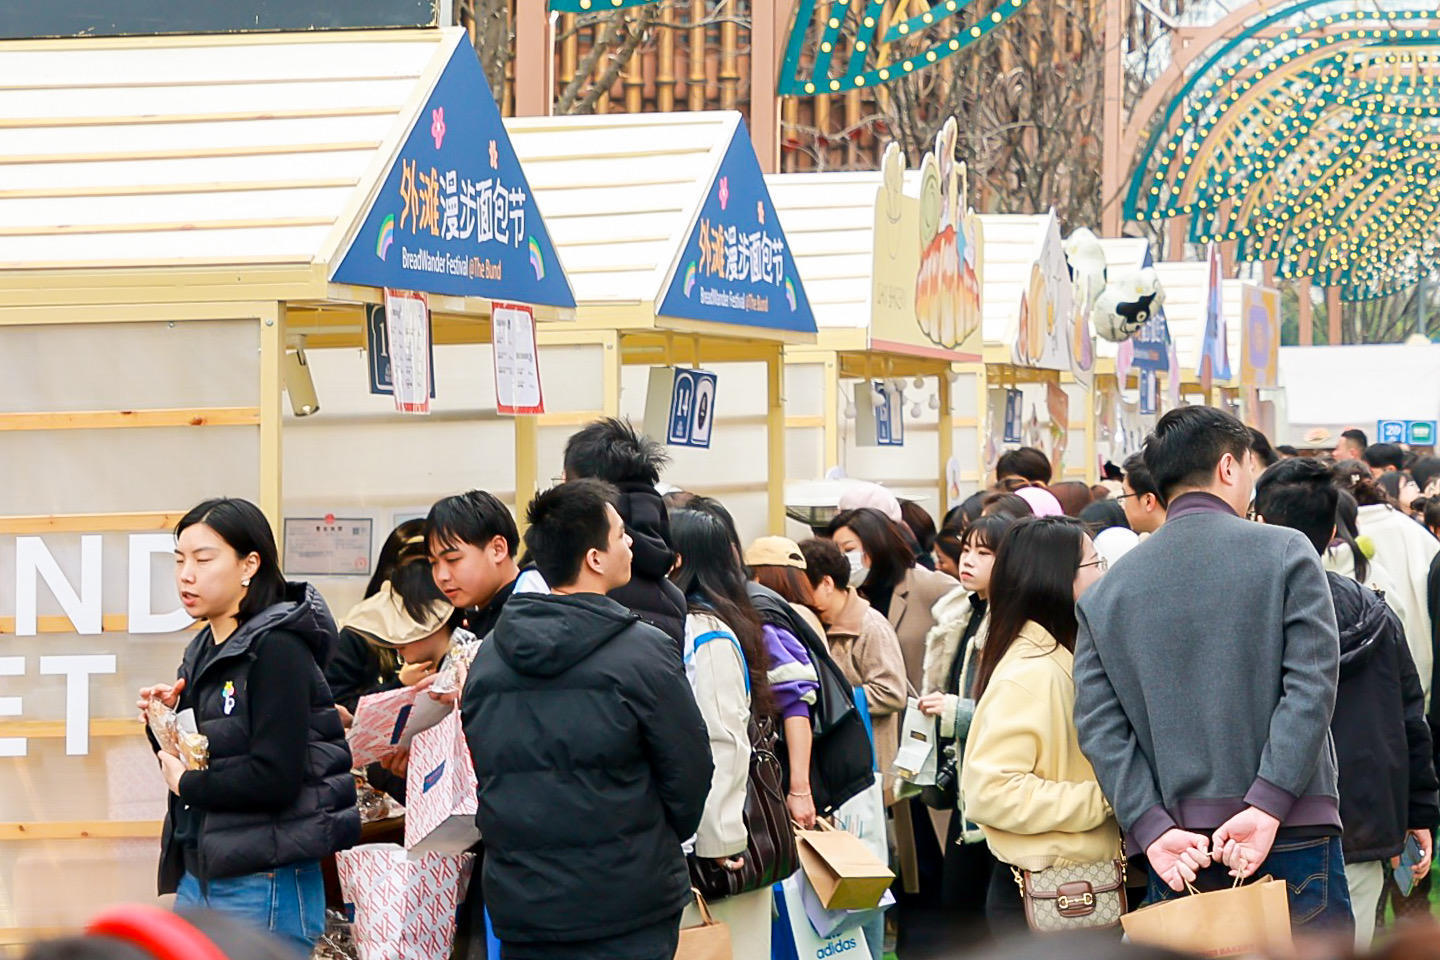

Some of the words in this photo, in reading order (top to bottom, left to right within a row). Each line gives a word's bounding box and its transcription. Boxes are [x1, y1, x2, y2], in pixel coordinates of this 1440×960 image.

[399, 157, 527, 249] 外滩漫步面包节
[698, 218, 784, 287] 外滩漫步面包节
[816, 938, 857, 960] adidas
